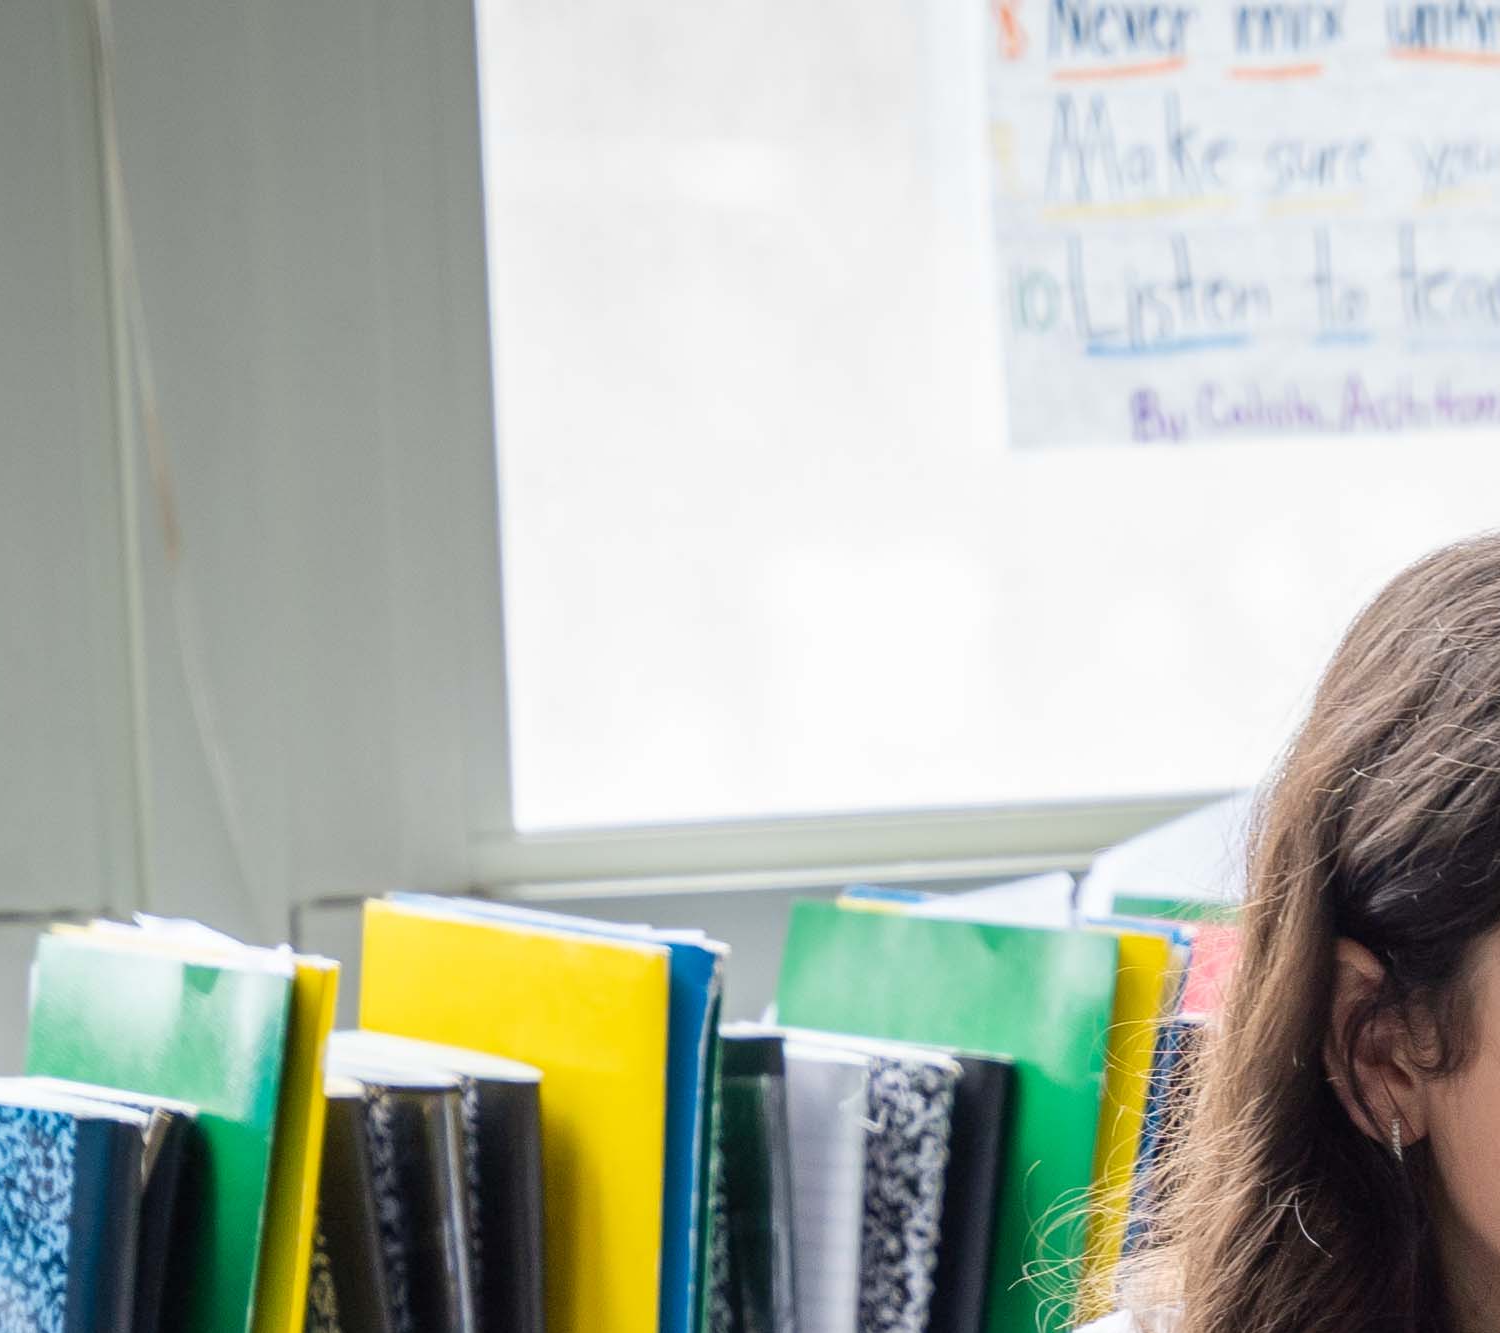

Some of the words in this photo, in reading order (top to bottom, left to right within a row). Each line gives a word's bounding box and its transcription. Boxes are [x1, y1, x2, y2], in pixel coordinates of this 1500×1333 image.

[1232, 0, 1345, 54] mix
[1044, 92, 1237, 205] Make
[1263, 135, 1373, 193] sure
[1066, 232, 1272, 347] Listen
[1307, 225, 1370, 325] to
